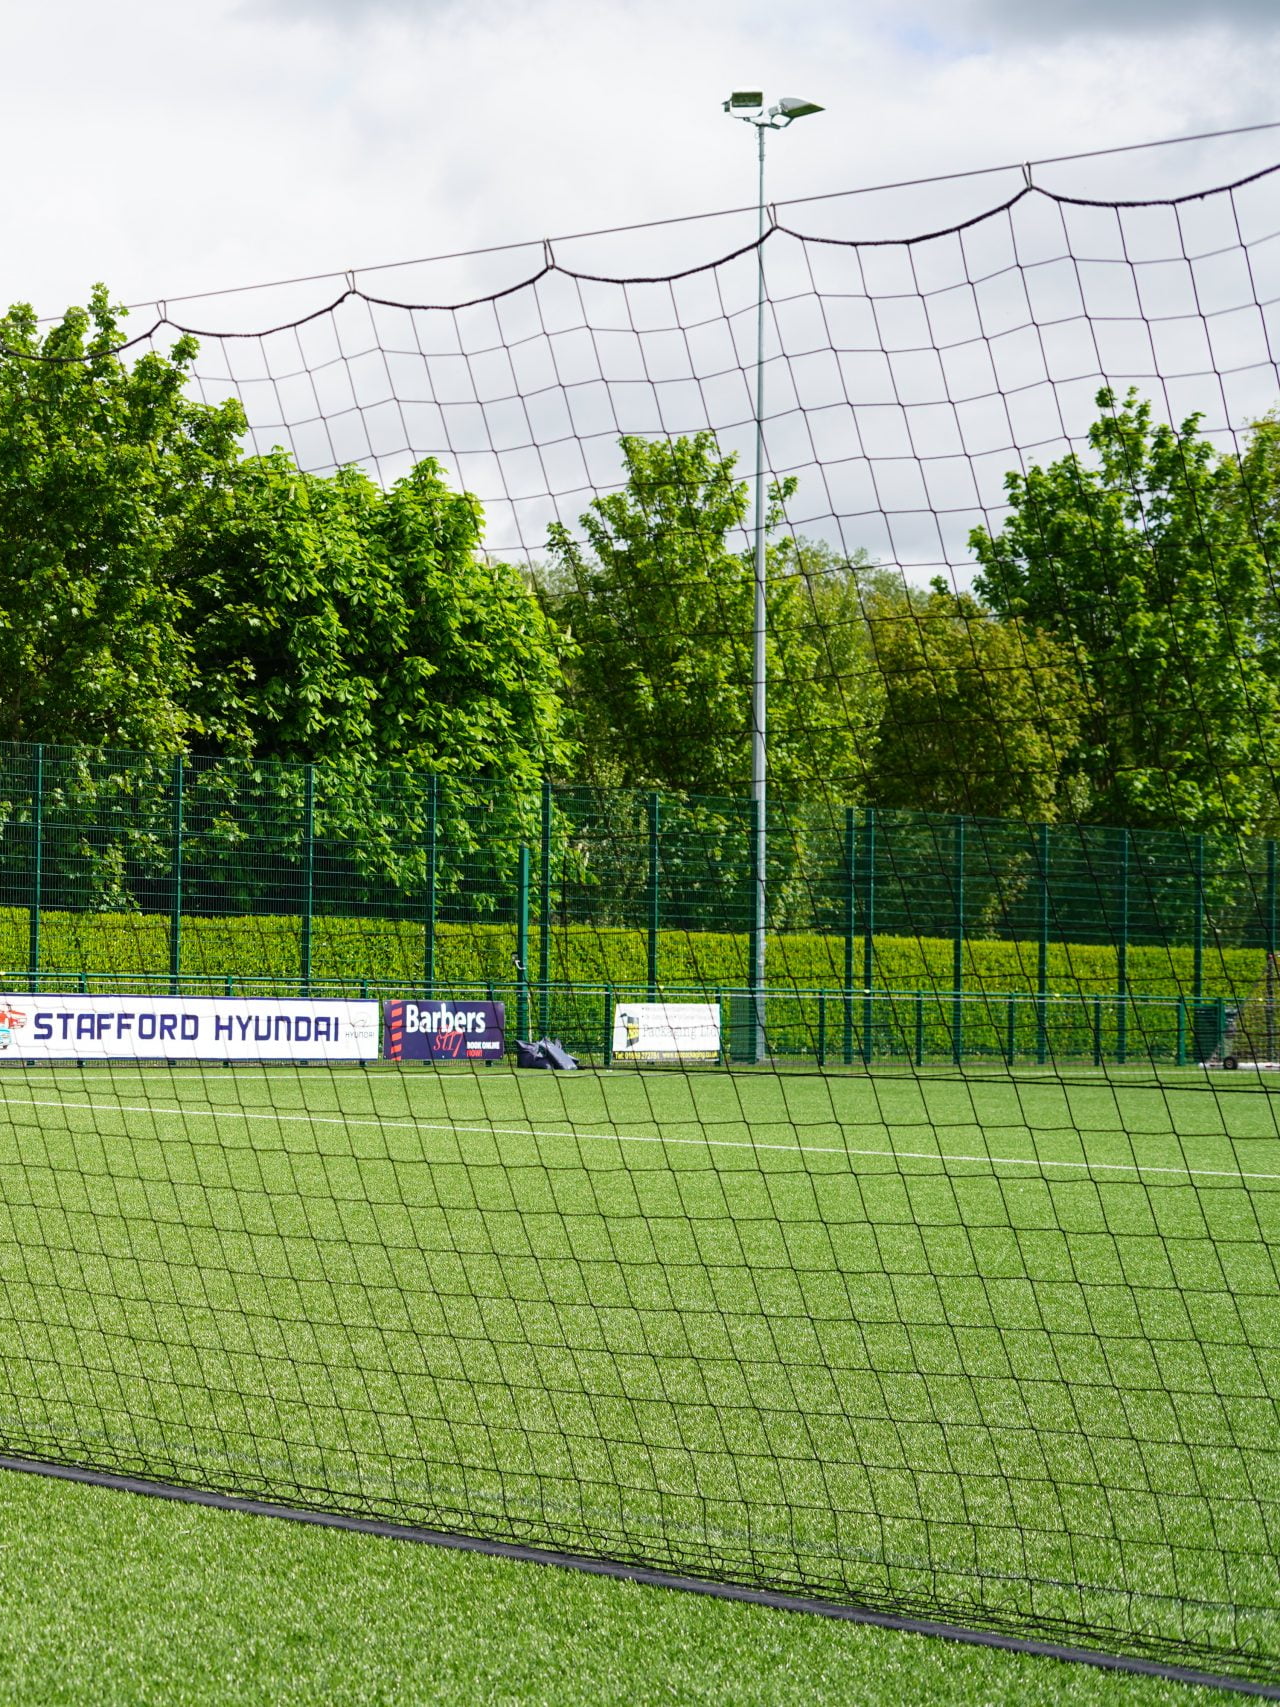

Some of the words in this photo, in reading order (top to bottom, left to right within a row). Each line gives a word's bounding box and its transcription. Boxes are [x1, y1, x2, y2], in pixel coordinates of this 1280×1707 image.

[33, 1012, 200, 1041] STAFFORD
[215, 1014, 339, 1042] HYUNDAI
[405, 1002, 487, 1034] Barbers
[345, 1031, 375, 1039] HYUNDAI
